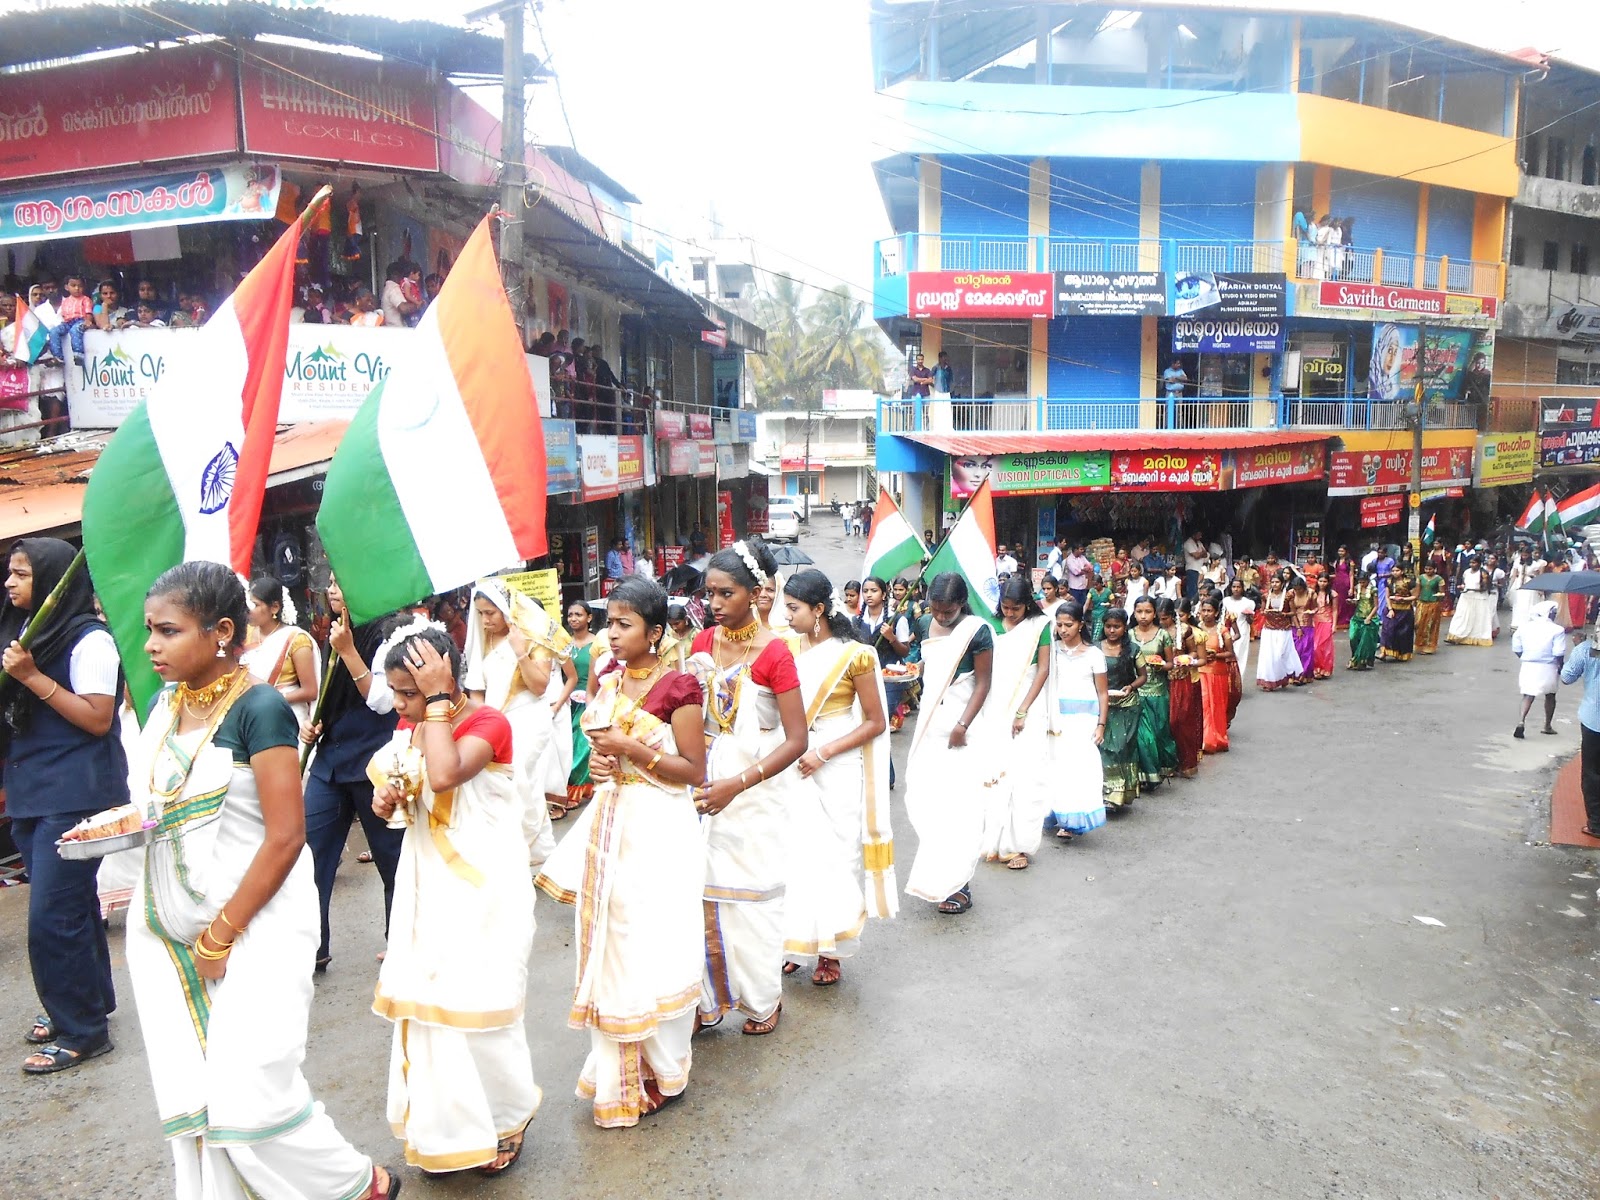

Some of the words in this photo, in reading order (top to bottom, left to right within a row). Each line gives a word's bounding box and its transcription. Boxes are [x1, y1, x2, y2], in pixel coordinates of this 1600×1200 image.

[14, 172, 214, 232] ആശംസകൾ
[1339, 286, 1385, 308] Savitha
[1388, 291, 1440, 312] Garments
[82, 356, 135, 391] Mount
[285, 351, 346, 381] Mount
[93, 387, 151, 398] RESIDE
[293, 382, 370, 392] RESIDEN
[1012, 455, 1068, 469] കണ്ണടകൾ
[1143, 454, 1188, 470] മരിയ
[1255, 448, 1292, 467] മരിയ
[997, 471, 1031, 483] VISION
[1033, 468, 1081, 481] OPTICALS
